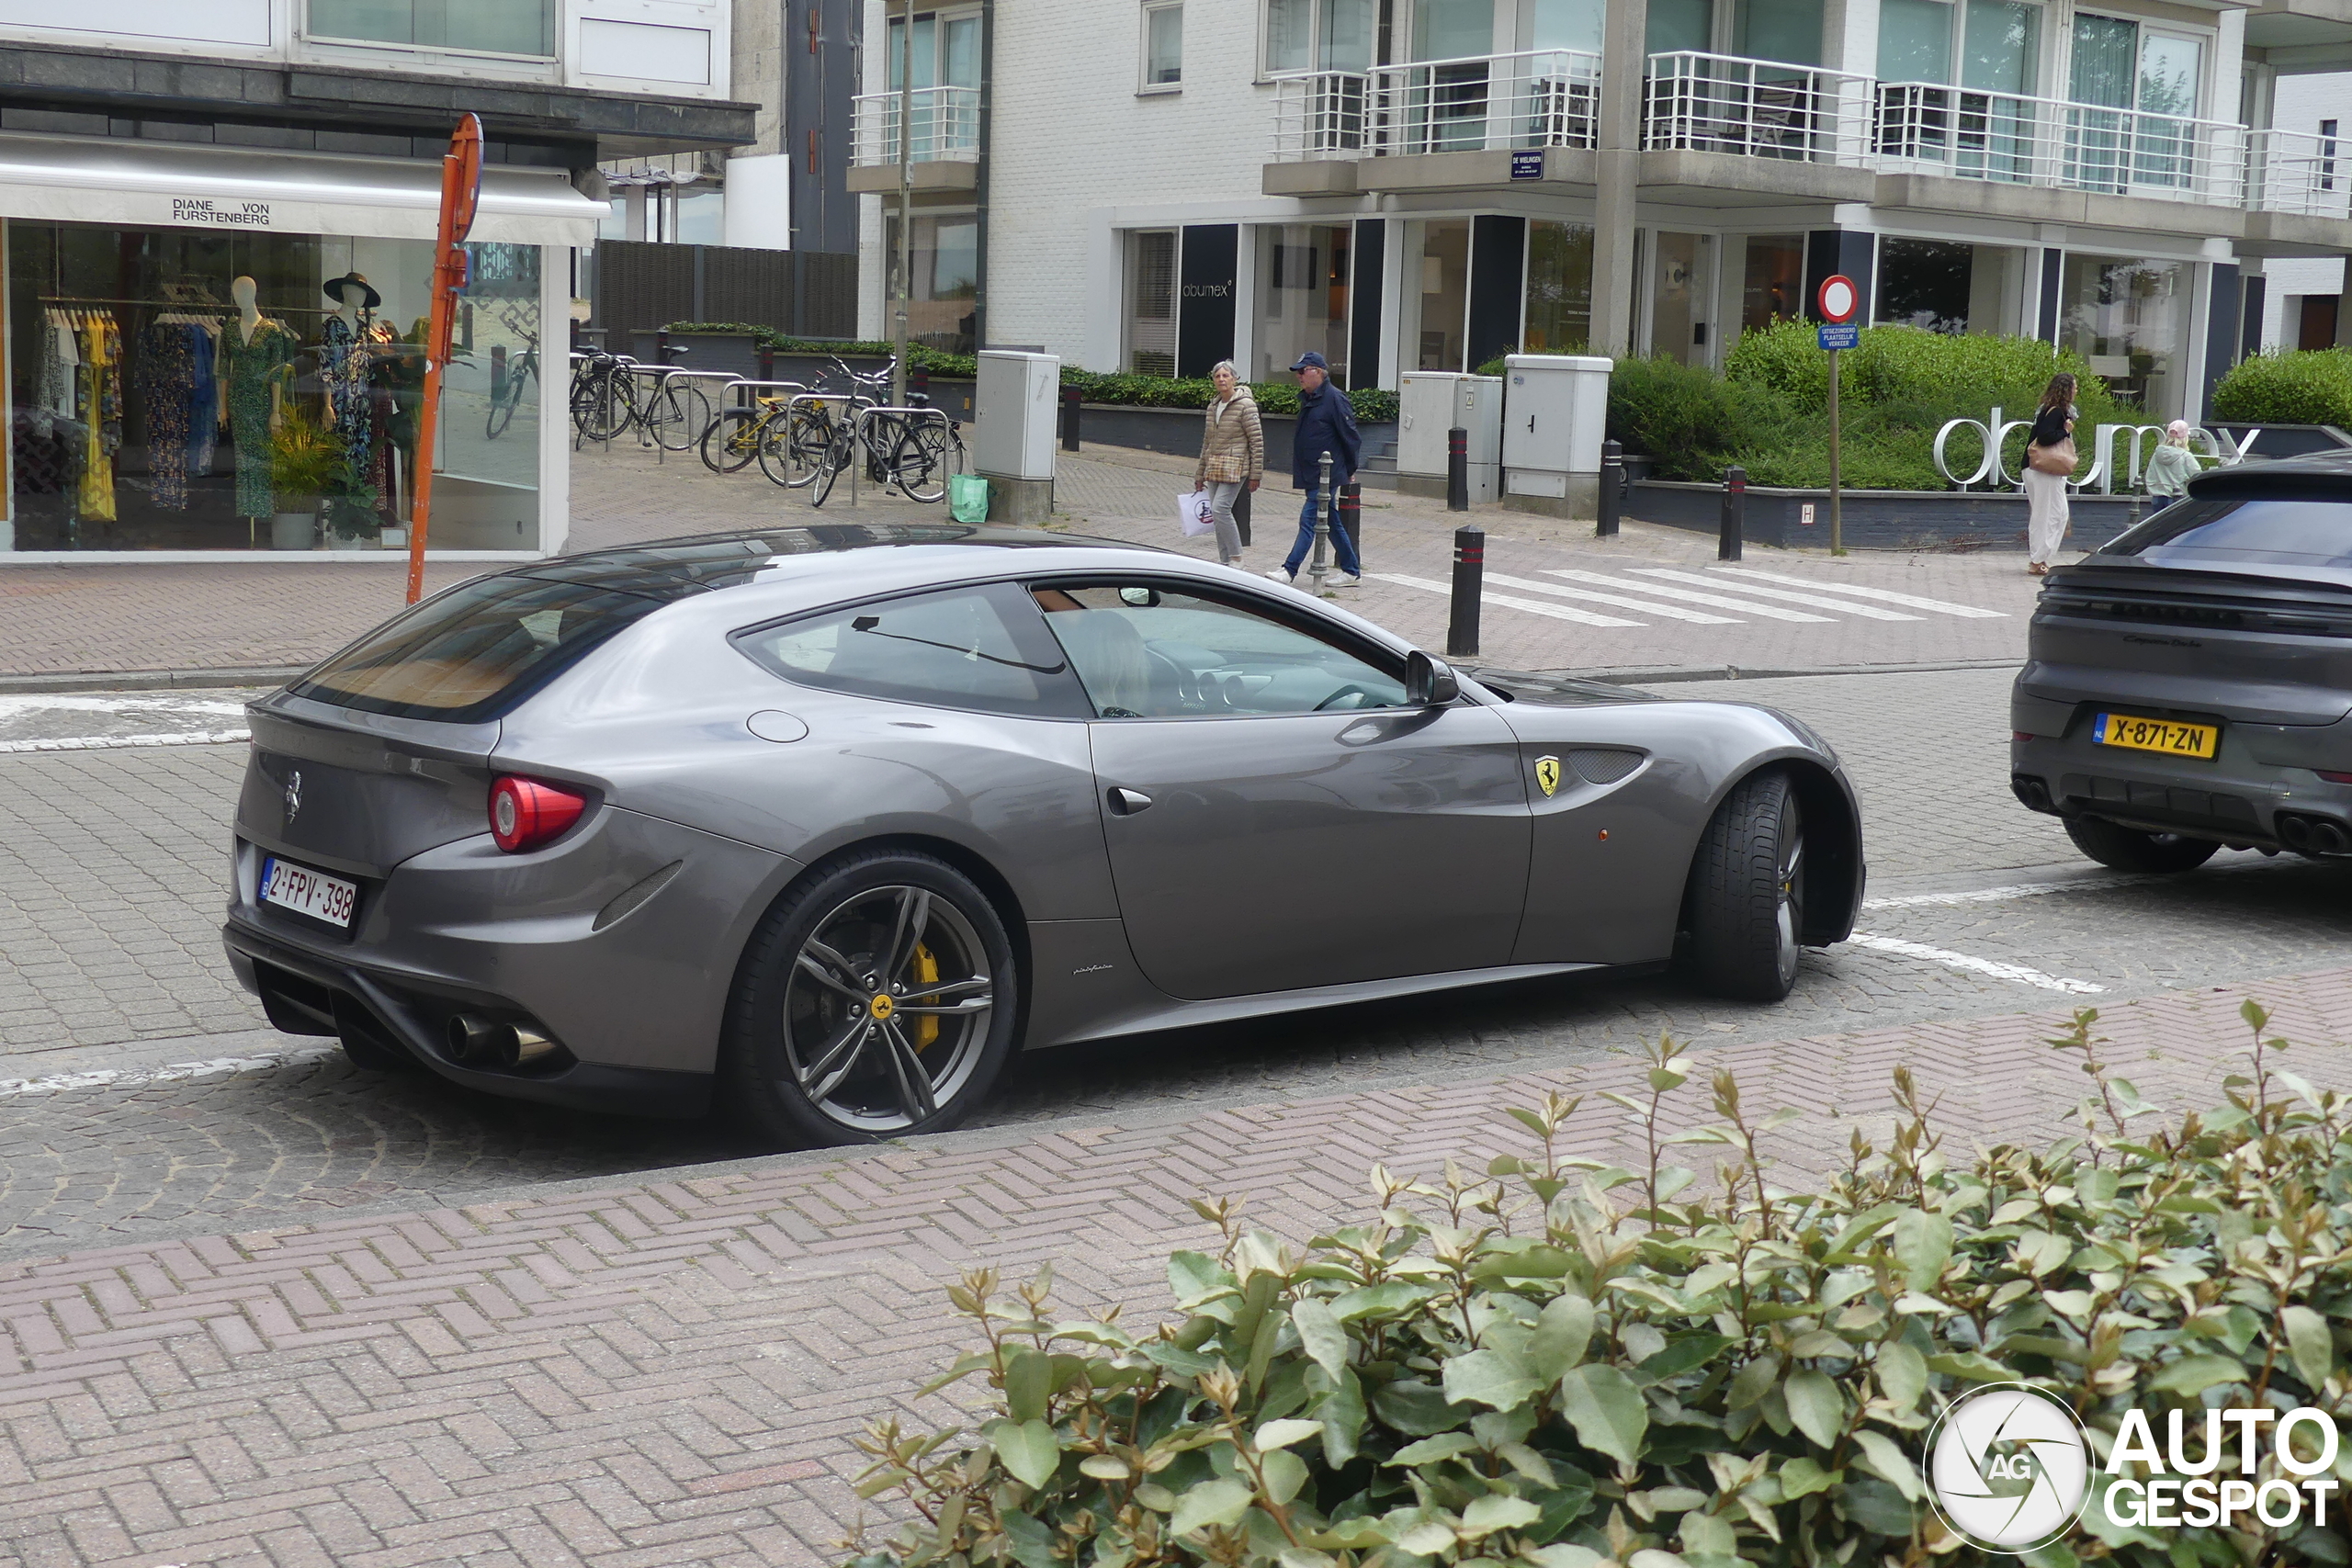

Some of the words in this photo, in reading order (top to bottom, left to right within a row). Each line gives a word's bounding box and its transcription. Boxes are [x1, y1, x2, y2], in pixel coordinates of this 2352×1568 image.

[173, 198, 213, 210] DIANE
[242, 203, 269, 214] VON
[173, 209, 269, 225] FURSTENBERG
[1804, 507, 1812, 521] H
[2094, 730, 2103, 739] NL
[2113, 719, 2204, 751] X-871-ZN
[262, 882, 269, 896] B
[269, 865, 354, 921] 2-FPV-398
